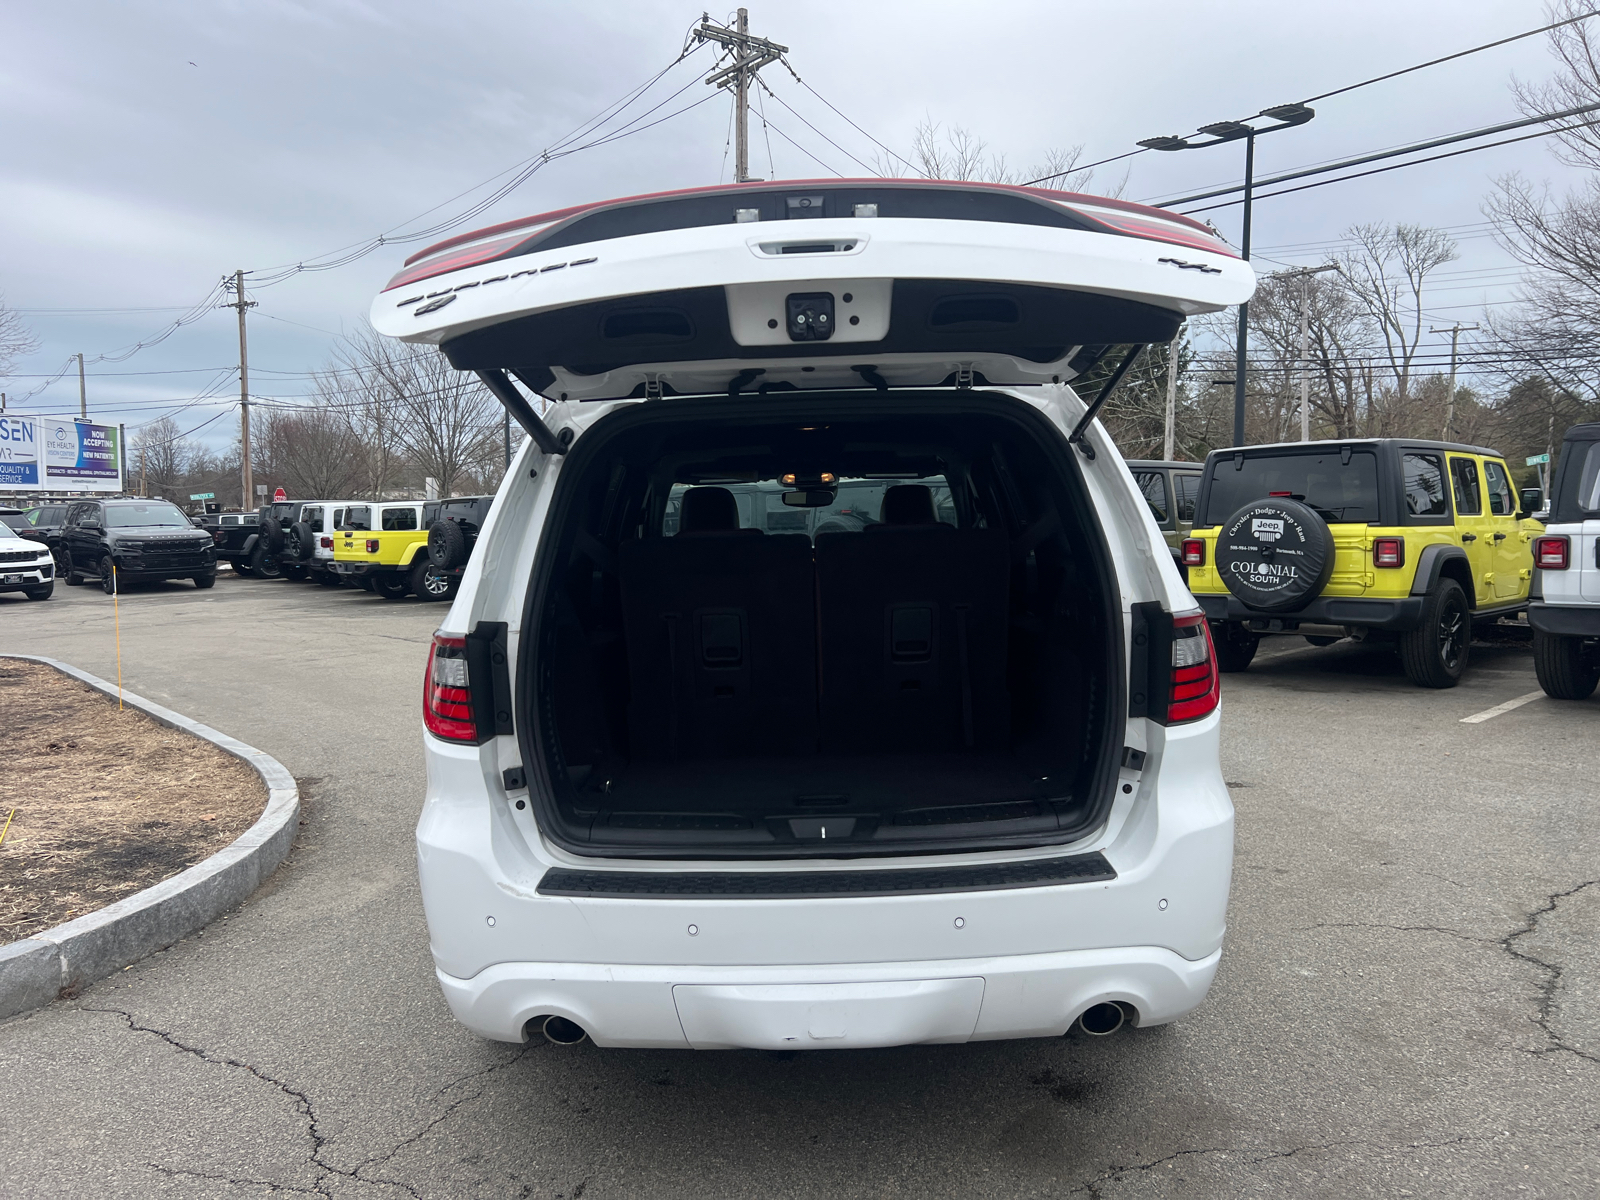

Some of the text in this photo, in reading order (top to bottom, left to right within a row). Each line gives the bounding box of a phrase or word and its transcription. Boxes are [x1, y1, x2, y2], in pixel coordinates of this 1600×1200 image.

[91, 430, 105, 439] NOW
[47, 441, 75, 450] EYE HEALTH
[83, 438, 114, 448] ACCEPTING
[82, 451, 94, 459] NEW
[25, 466, 30, 474] &
[1229, 507, 1306, 543] Chrysler Dodge Jeep Ram
[1257, 520, 1279, 530] Jeep
[1230, 561, 1298, 578] COLONIAL
[1250, 574, 1279, 584] SOUTH
